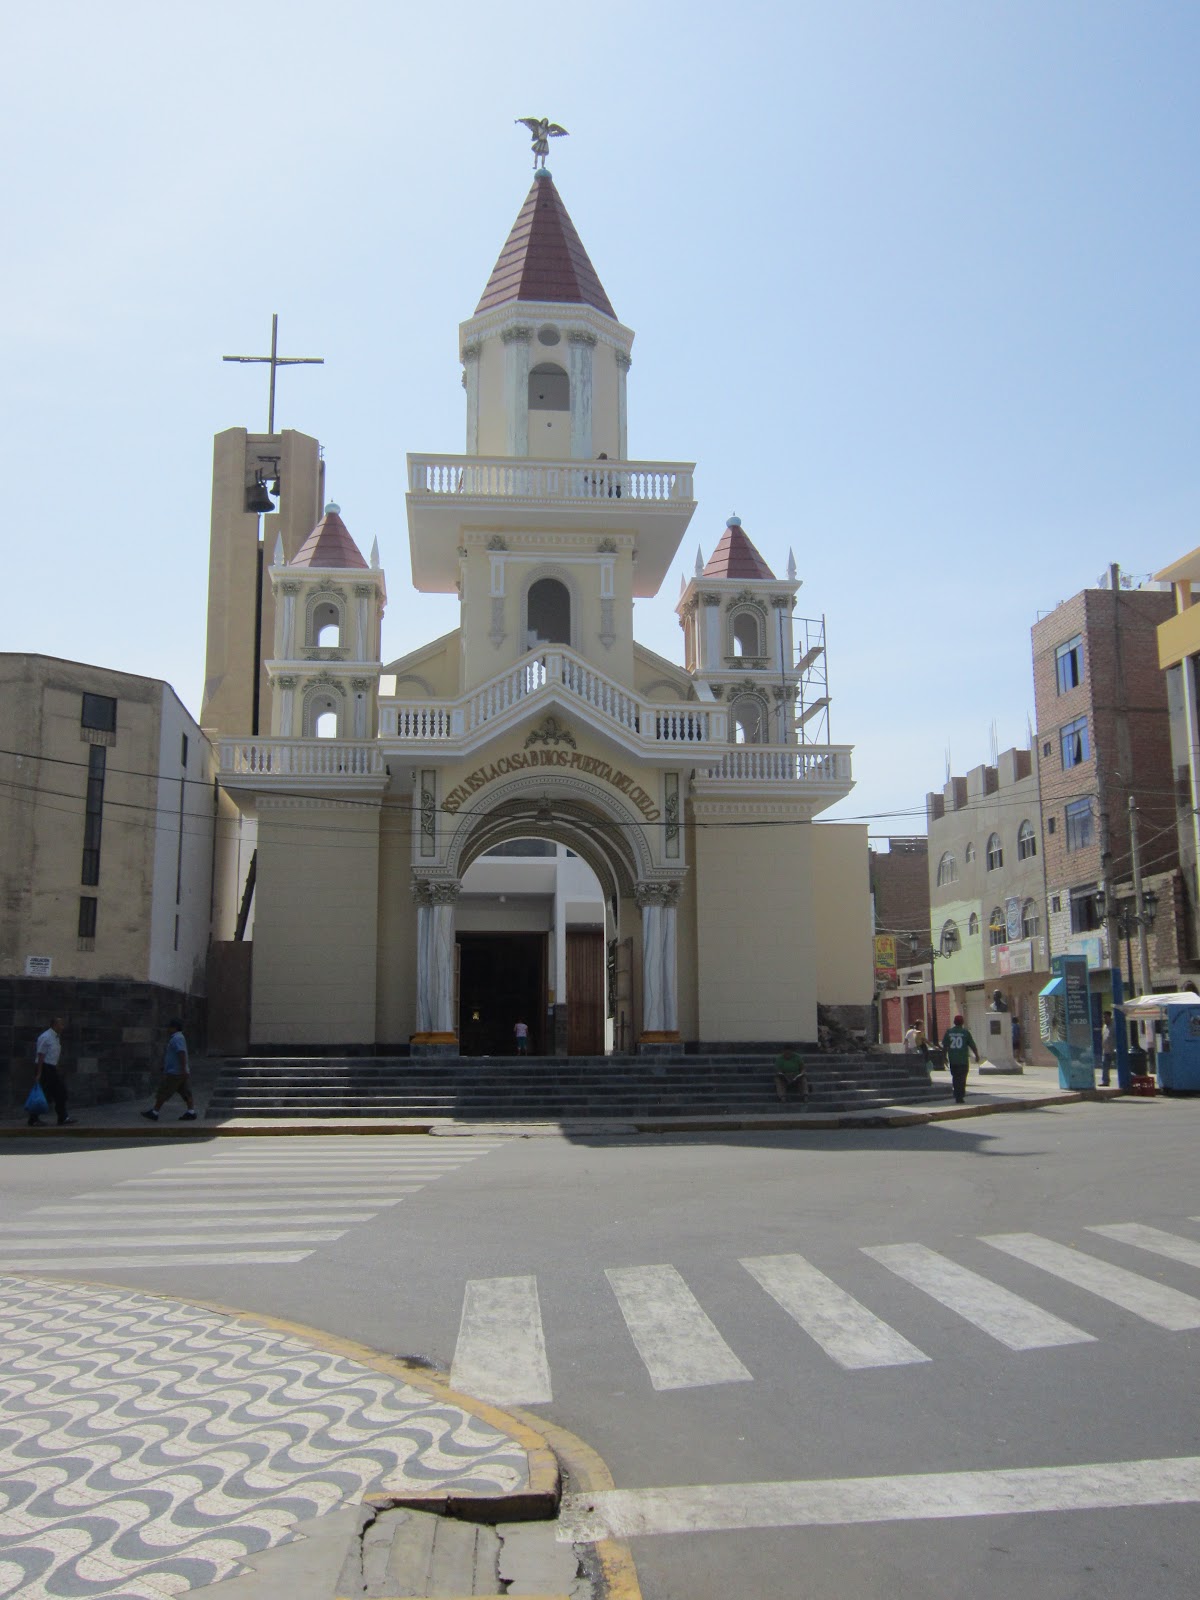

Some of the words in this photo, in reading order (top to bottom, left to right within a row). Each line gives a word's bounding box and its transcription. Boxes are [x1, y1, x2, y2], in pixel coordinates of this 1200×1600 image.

[440, 784, 472, 816] ESTA
[464, 771, 485, 792] ES
[479, 763, 501, 783] LA
[497, 752, 531, 774] CASA
[610, 770, 635, 794] DEL
[628, 786, 661, 821] CIELO
[950, 1036, 963, 1049] 20
